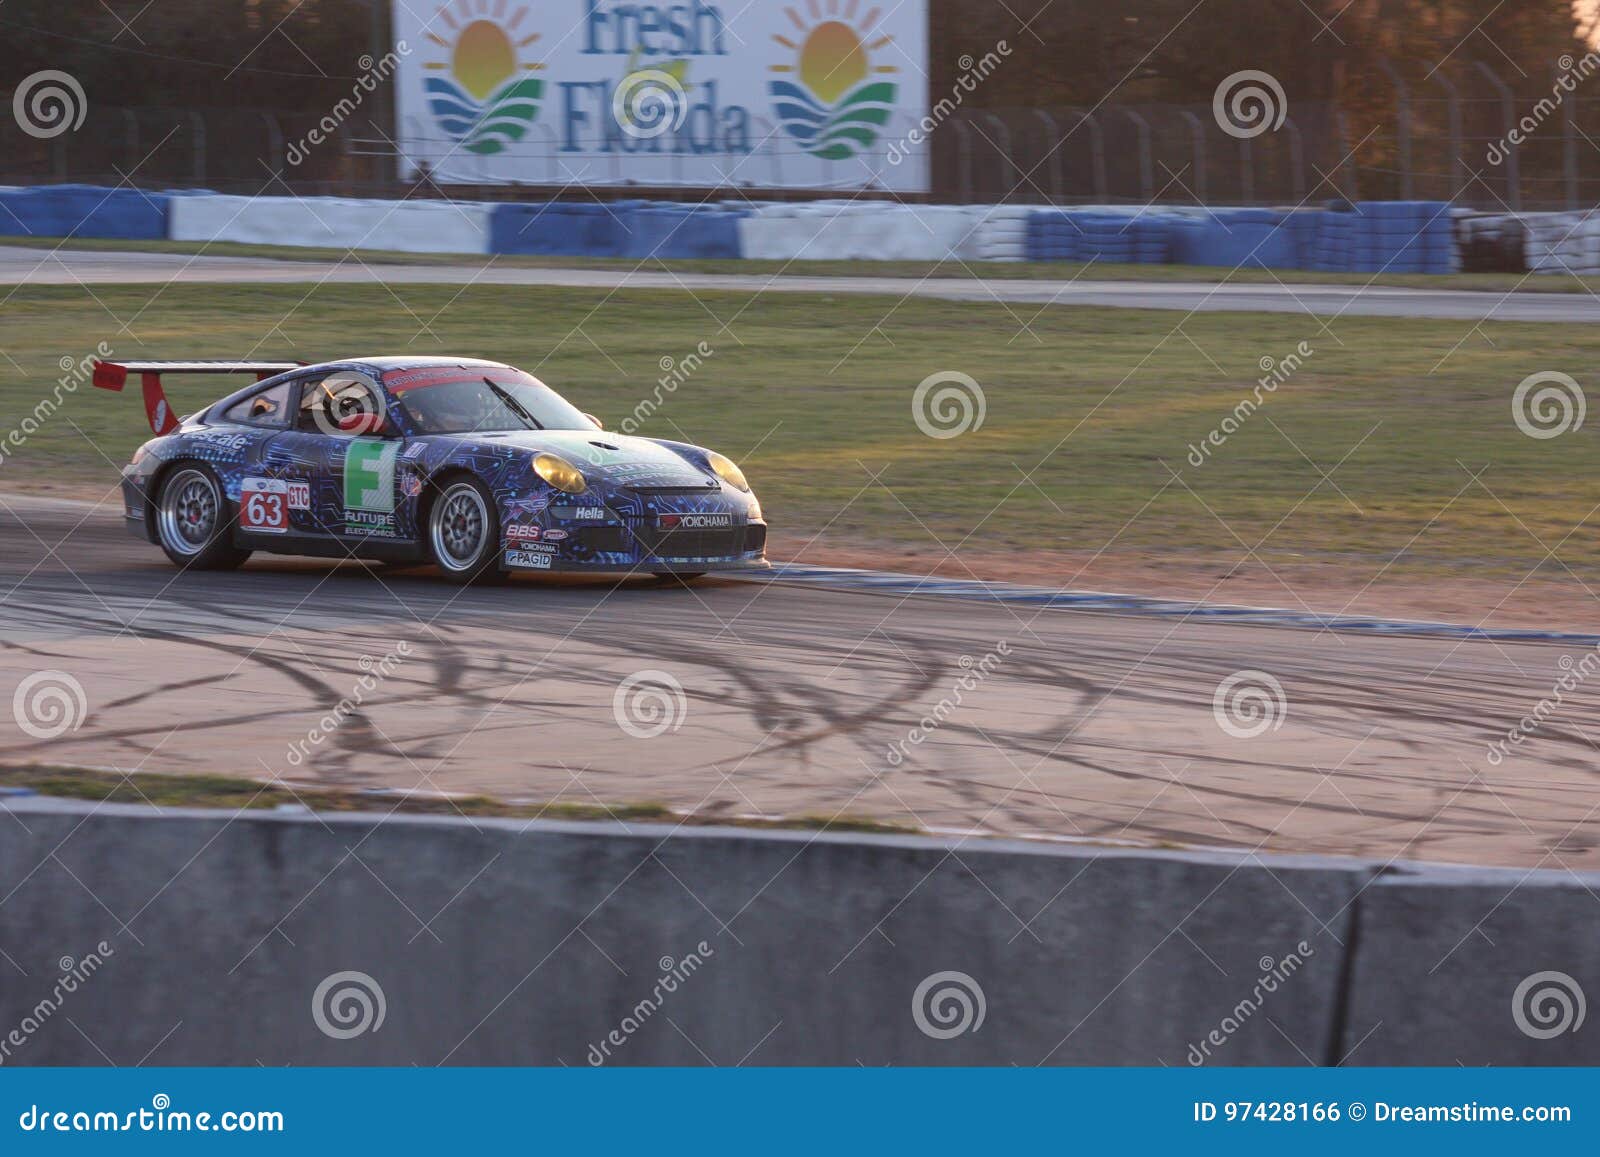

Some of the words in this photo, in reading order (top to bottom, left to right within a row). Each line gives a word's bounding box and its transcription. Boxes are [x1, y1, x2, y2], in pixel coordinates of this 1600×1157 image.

[579, 0, 728, 55] Fresh
[288, 486, 308, 506] GTC
[247, 493, 283, 526] 63
[575, 507, 605, 519] Hella
[344, 512, 395, 525] FUTURE
[679, 515, 729, 527] YOKOHAMA
[506, 524, 540, 537] BBS
[519, 543, 557, 553] YOKOHAMA
[517, 552, 551, 566] PAGID
